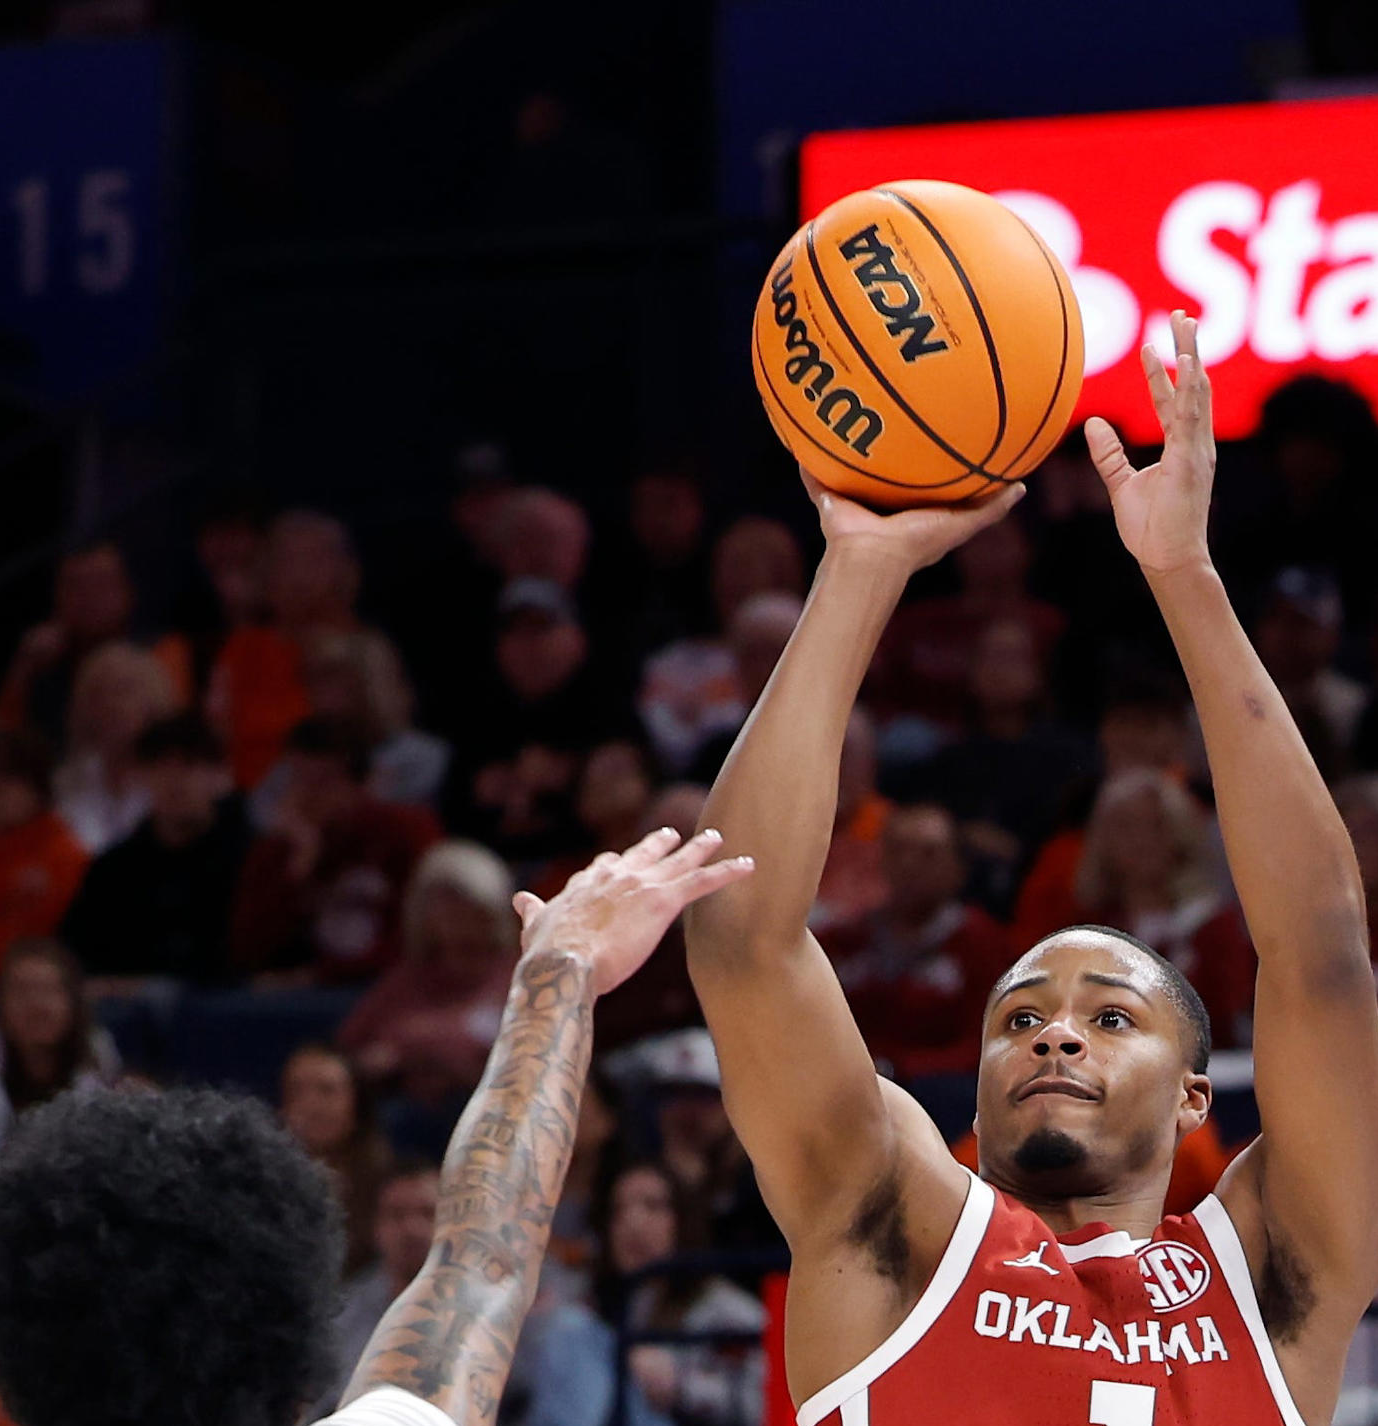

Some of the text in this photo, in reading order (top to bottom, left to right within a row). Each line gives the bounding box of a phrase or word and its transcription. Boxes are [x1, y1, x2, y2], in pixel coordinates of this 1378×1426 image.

[772, 256, 883, 457] Wilson
[839, 224, 948, 363] NCAA
[974, 1289, 1230, 1377] OKLAHMA
